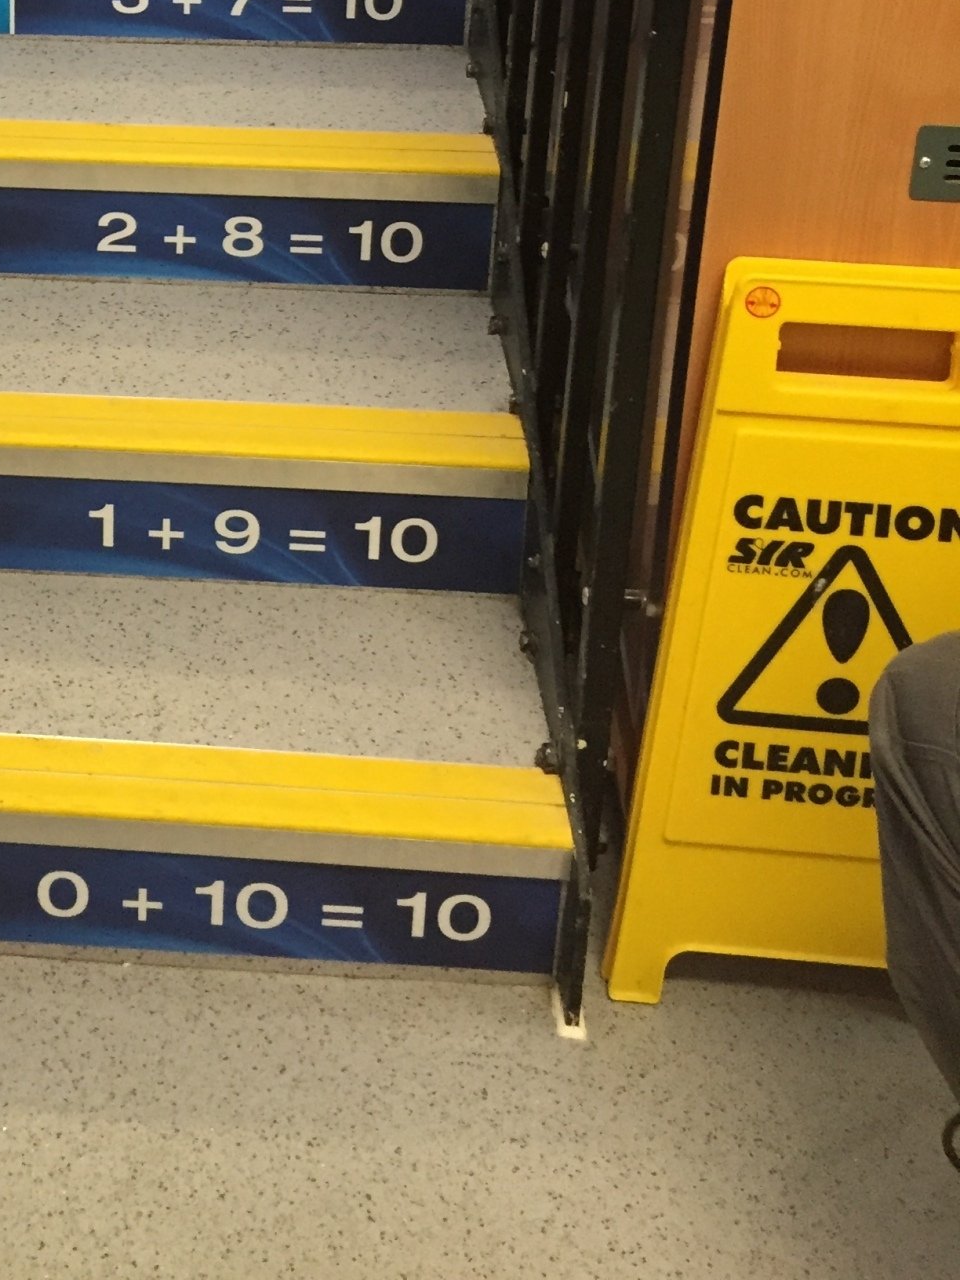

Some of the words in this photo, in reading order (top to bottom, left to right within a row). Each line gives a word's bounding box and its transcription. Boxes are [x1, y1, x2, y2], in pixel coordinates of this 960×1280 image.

[96, 211, 137, 253] 2
[163, 224, 197, 255] +
[222, 216, 264, 258] 8
[289, 234, 324, 254] =
[348, 220, 423, 263] 10
[88, 503, 115, 548] 1
[148, 518, 185, 550] +
[214, 509, 260, 555] 9
[288, 529, 326, 552] =
[354, 516, 438, 563] 10
[726, 563, 813, 579] CLEAN.COM
[710, 774, 749, 798] IN
[37, 870, 89, 918] 0
[122, 888, 163, 922] +
[195, 880, 289, 930] 10
[321, 904, 364, 929] =
[396, 892, 491, 942] 10
